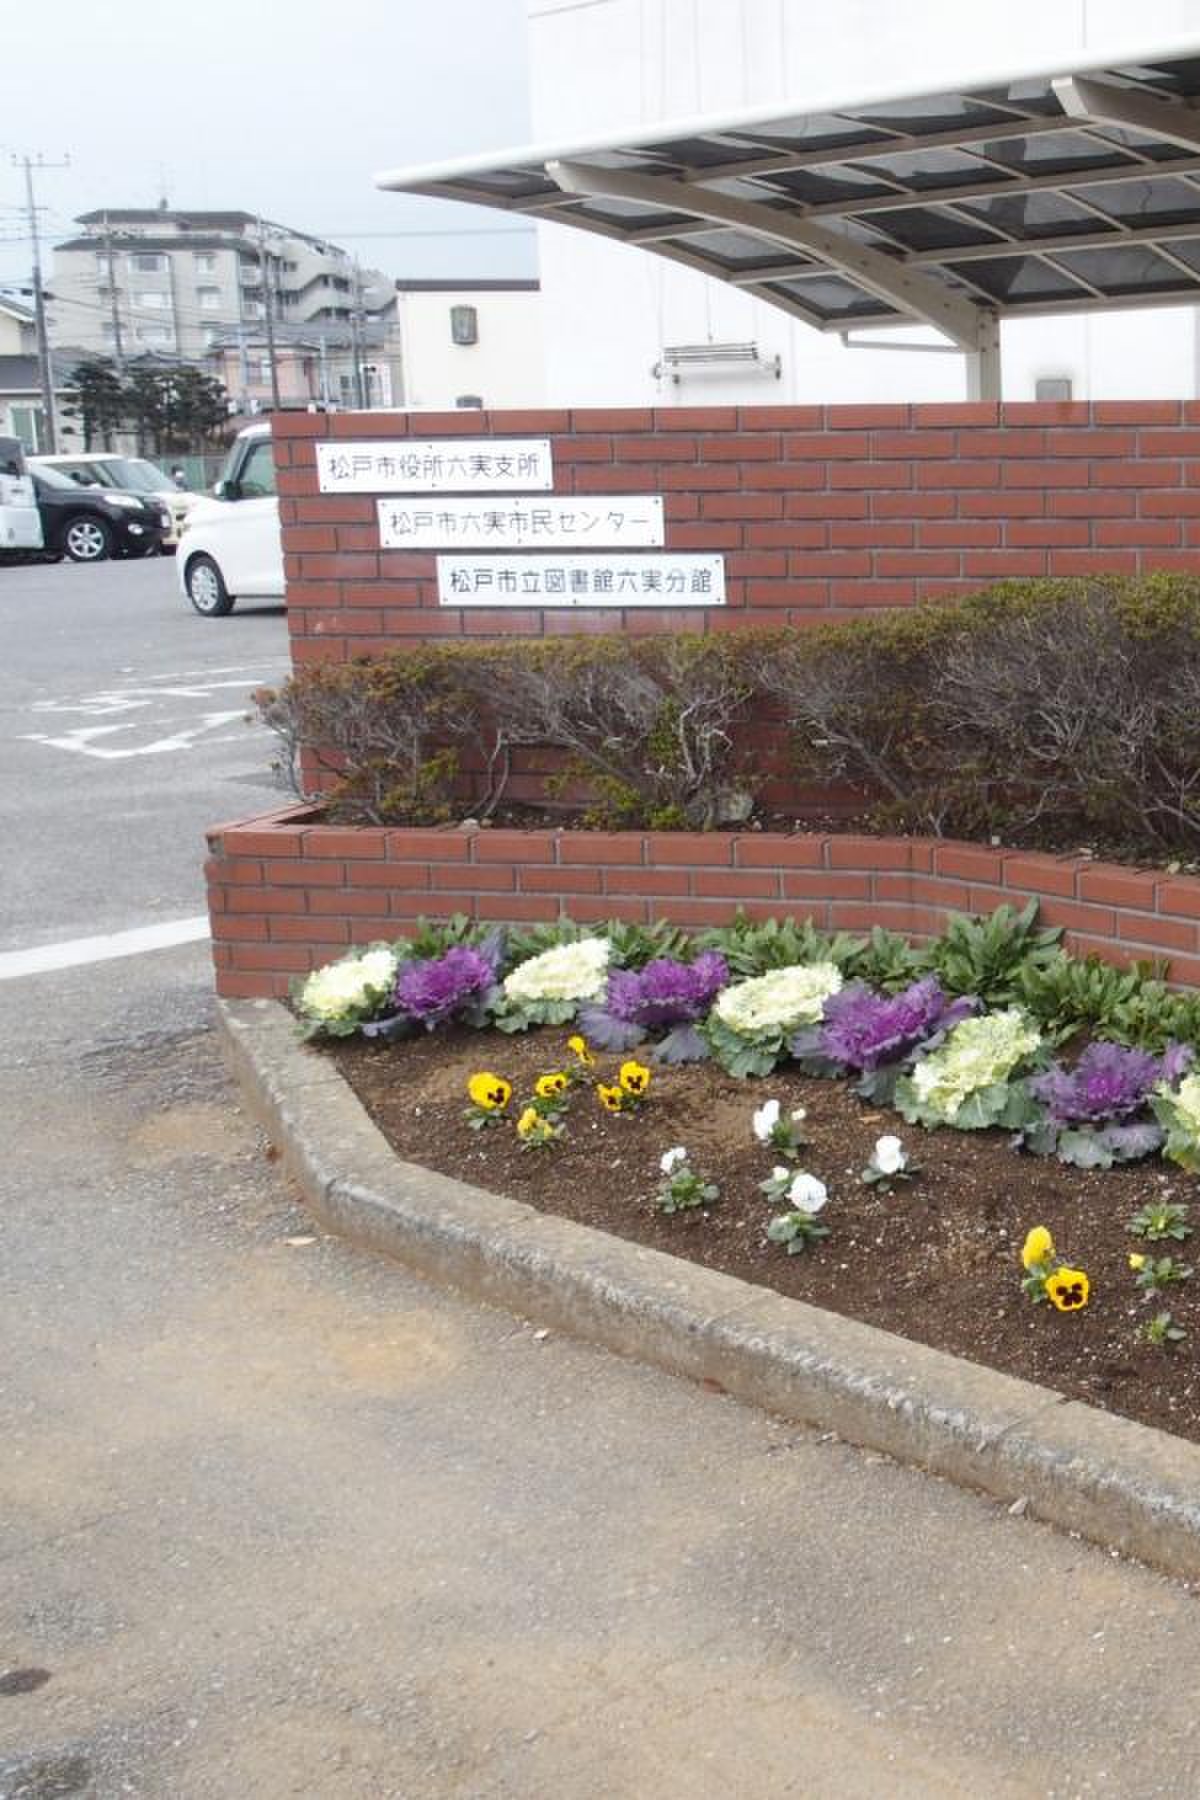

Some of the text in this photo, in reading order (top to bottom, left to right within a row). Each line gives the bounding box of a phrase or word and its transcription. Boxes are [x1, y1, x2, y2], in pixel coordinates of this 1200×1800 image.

[328, 452, 541, 481] 松戸市役所六実支所
[389, 509, 650, 536] 松戸市六実市民センター
[450, 568, 713, 594] 松戸市立図書館六実分館
